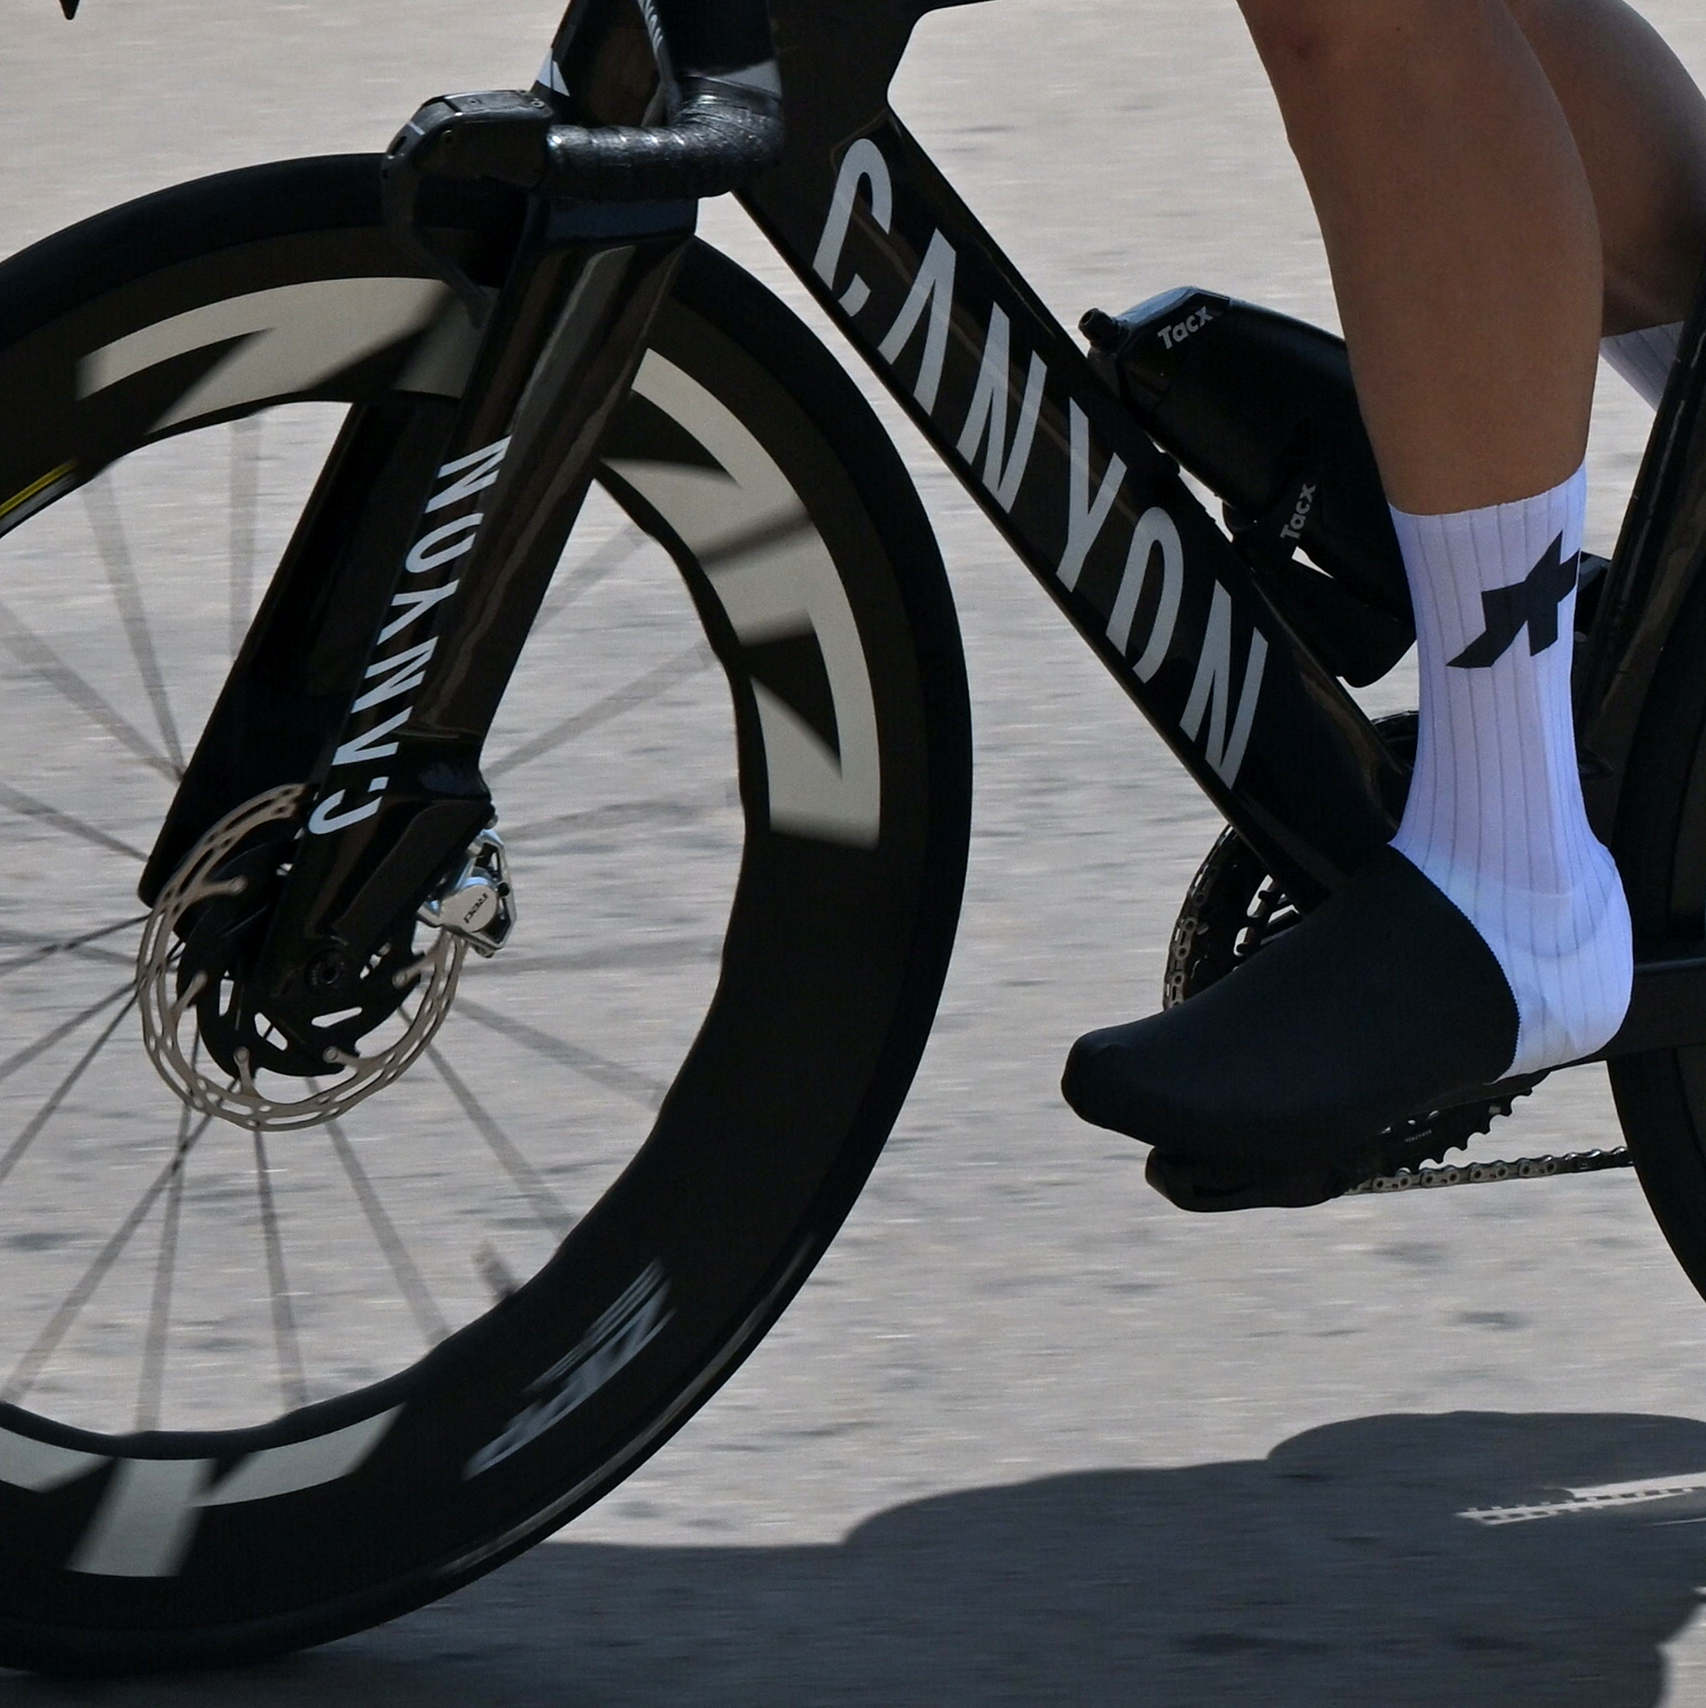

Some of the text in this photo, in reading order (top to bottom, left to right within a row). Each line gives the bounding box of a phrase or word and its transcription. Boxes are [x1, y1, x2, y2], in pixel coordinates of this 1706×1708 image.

[1156, 304, 1214, 350] Tacx
[811, 137, 1269, 791] CANYON
[1279, 481, 1317, 542] Tacx
[308, 435, 511, 837] CANYON
